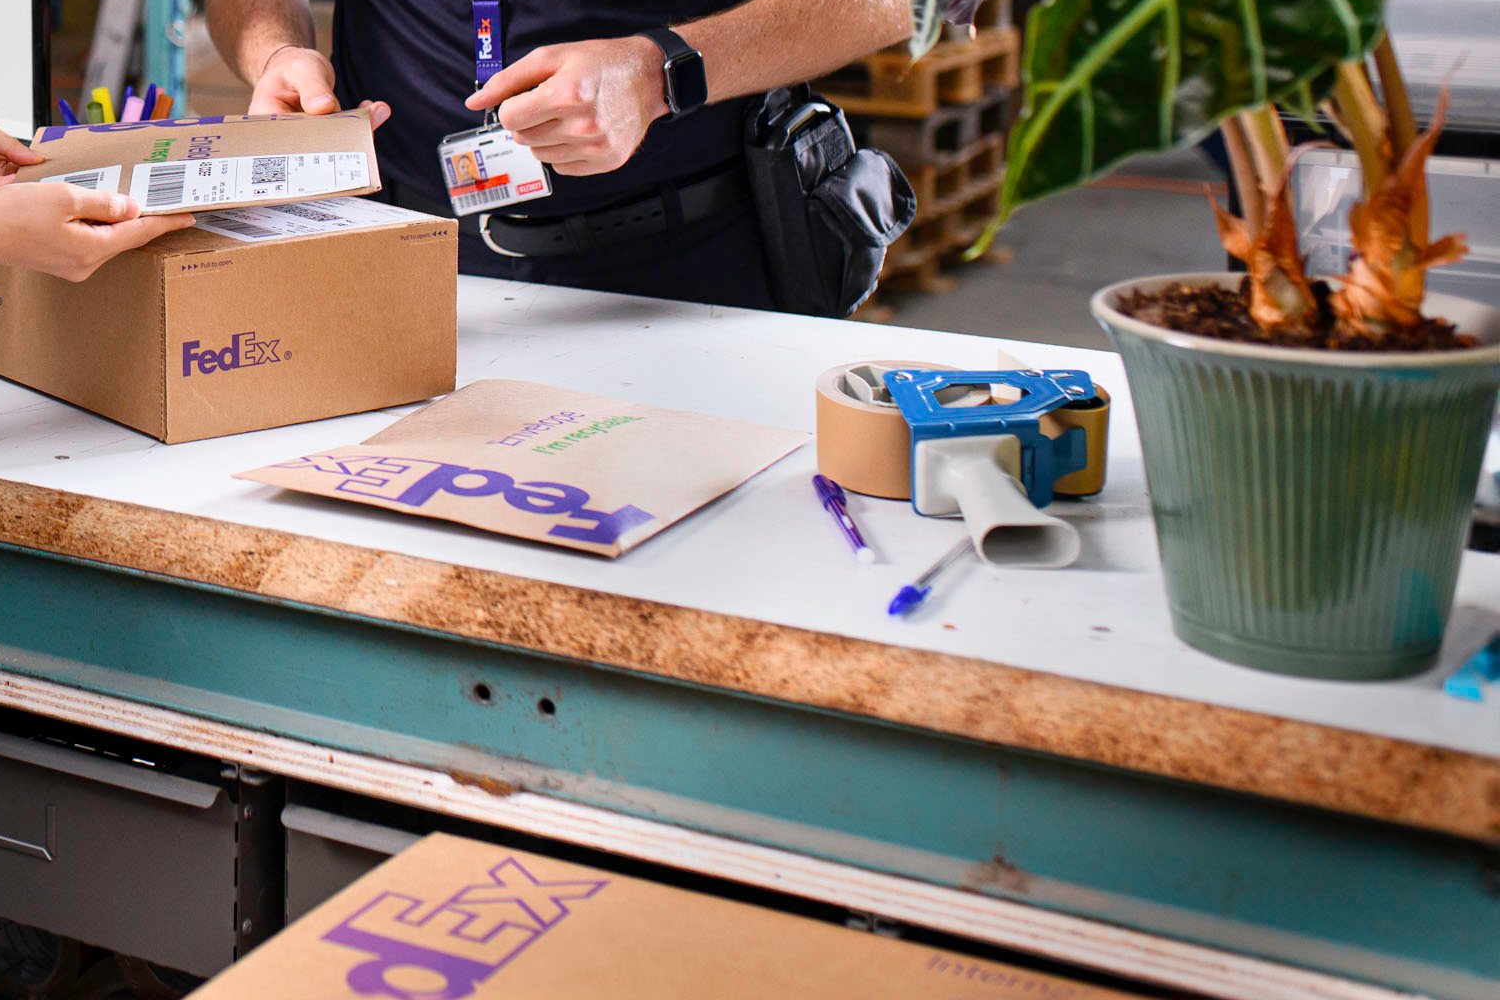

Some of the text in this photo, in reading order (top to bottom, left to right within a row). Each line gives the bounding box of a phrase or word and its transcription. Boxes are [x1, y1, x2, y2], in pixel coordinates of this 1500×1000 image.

[477, 17, 493, 60] FedEx
[200, 261, 211, 269] Pull
[182, 331, 281, 377] FedEx
[485, 410, 586, 447] Envelope
[531, 440, 573, 455] I'm
[271, 455, 656, 546] FedEx
[320, 856, 610, 1000] dEx
